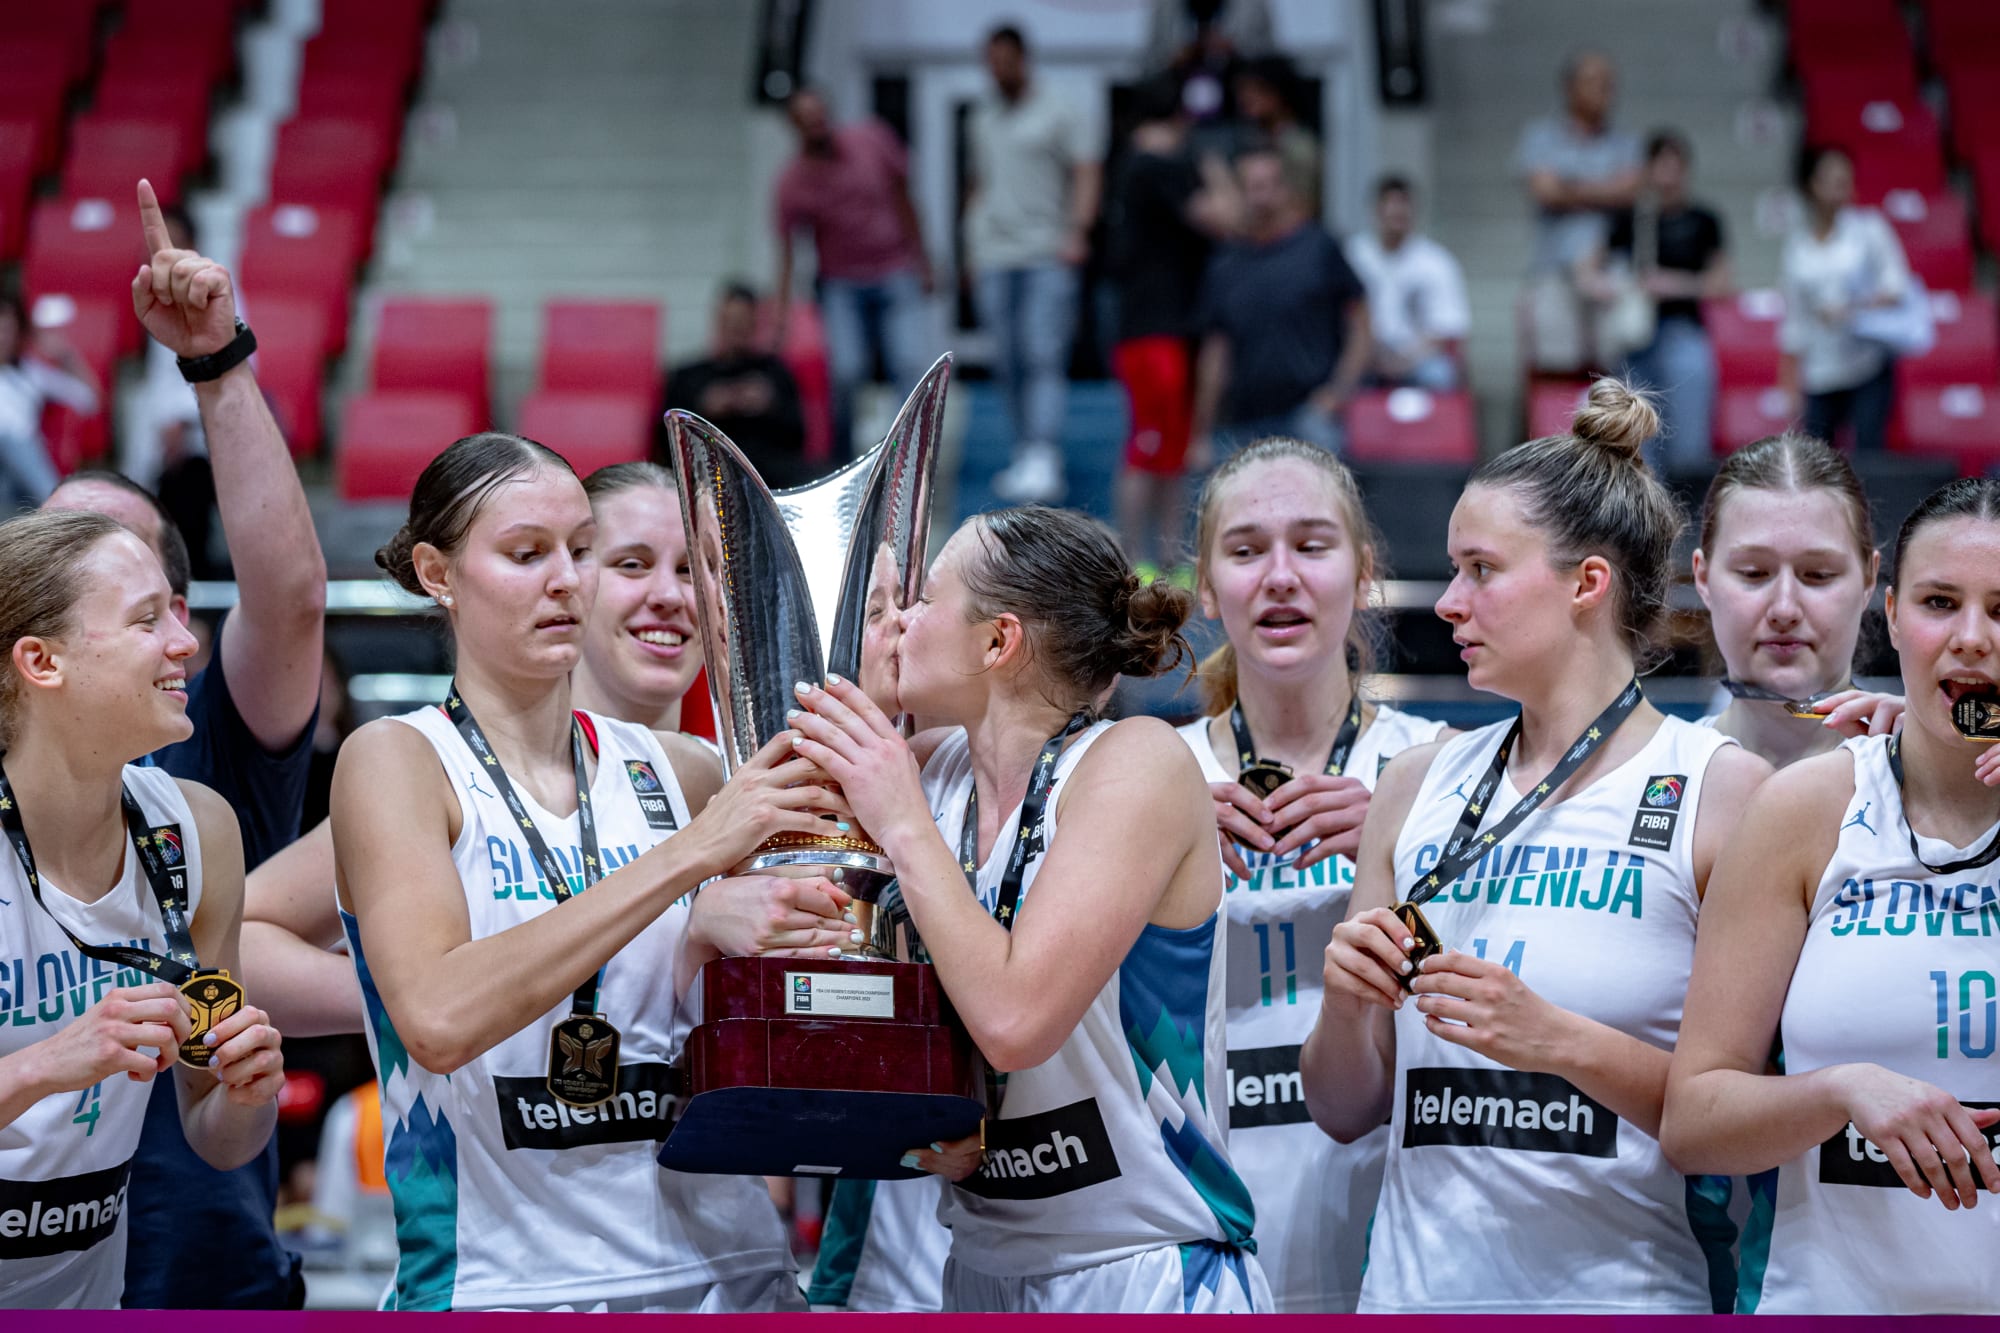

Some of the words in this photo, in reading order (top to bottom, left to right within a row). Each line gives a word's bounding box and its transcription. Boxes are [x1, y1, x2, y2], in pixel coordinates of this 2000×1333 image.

[639, 799, 667, 812] FIBA
[1640, 814, 1669, 830] FIBA
[1830, 878, 2000, 937] SLOVEN
[1253, 922, 1297, 1007] 11
[1929, 970, 1997, 1059] 10
[1413, 1086, 1594, 1136] telemach
[989, 1130, 1088, 1178] mach
[0, 1171, 131, 1239] elemac
